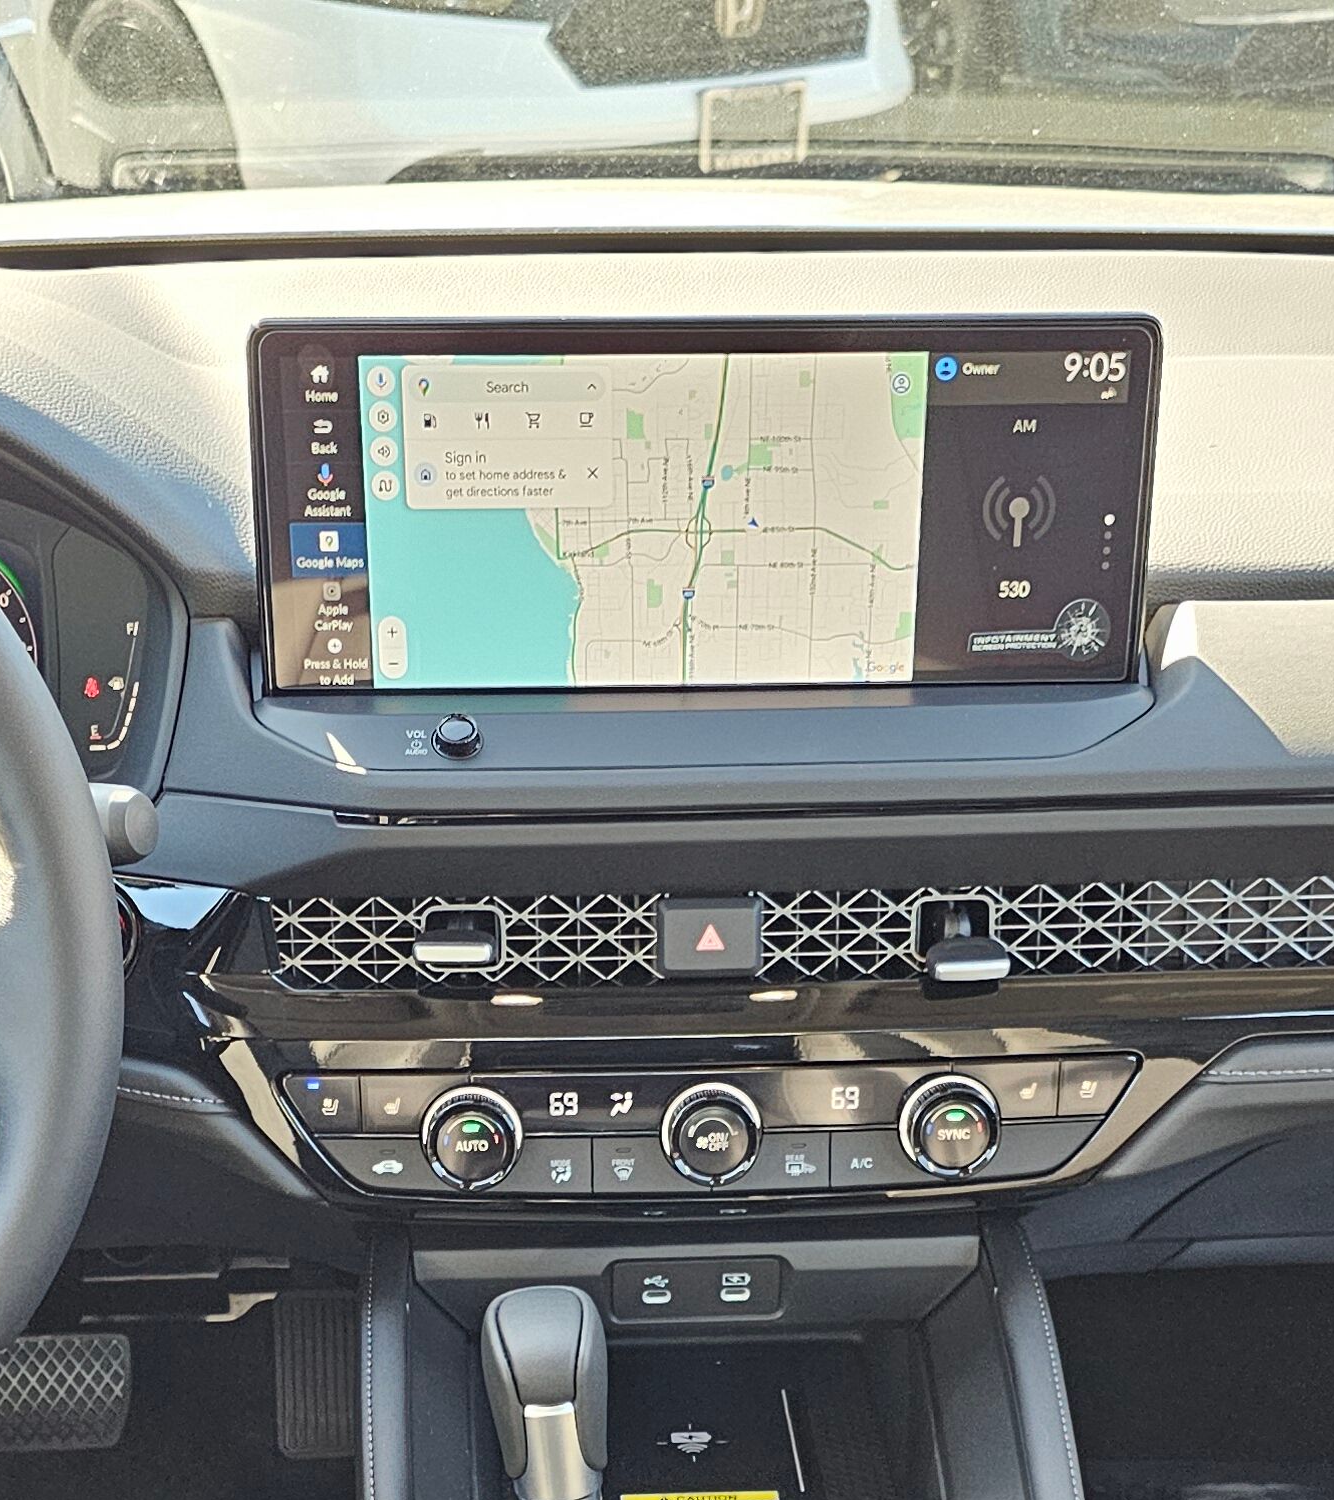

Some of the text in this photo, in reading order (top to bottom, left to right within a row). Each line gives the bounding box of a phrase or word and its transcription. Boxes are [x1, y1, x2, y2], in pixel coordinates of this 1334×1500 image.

[962, 362, 1000, 375] Owner
[1064, 352, 1127, 382] 9:05
[486, 381, 529, 394] Search
[305, 390, 338, 403] Home
[1013, 420, 1037, 433] AM
[311, 442, 338, 455] Back
[445, 451, 487, 465] Sign in
[445, 469, 567, 481] to set home address &
[307, 489, 346, 502] Google
[445, 486, 554, 499] get directions faster
[304, 504, 352, 518] Assistant
[296, 556, 365, 570] Google Maps
[998, 580, 1031, 598] 530
[318, 603, 349, 617] Apple
[314, 620, 354, 632] CarPlay
[973, 633, 1057, 645] INFOTAINMENT
[1005, 641, 1057, 650] PROTECTION
[303, 658, 369, 670] Press & Hold
[319, 674, 355, 686] to Add
[90, 724, 99, 736] E
[405, 730, 427, 739] VOL
[549, 1092, 579, 1117] 69
[831, 1086, 860, 1110] 69
[707, 1132, 729, 1143] ON/
[937, 1128, 971, 1141] SYNC
[455, 1140, 489, 1153] AUTO
[708, 1142, 729, 1152] OFF
[550, 1159, 572, 1168] MODE
[611, 1159, 635, 1167] FRONT
[785, 1154, 805, 1162] REAR
[850, 1157, 873, 1170] A/C
